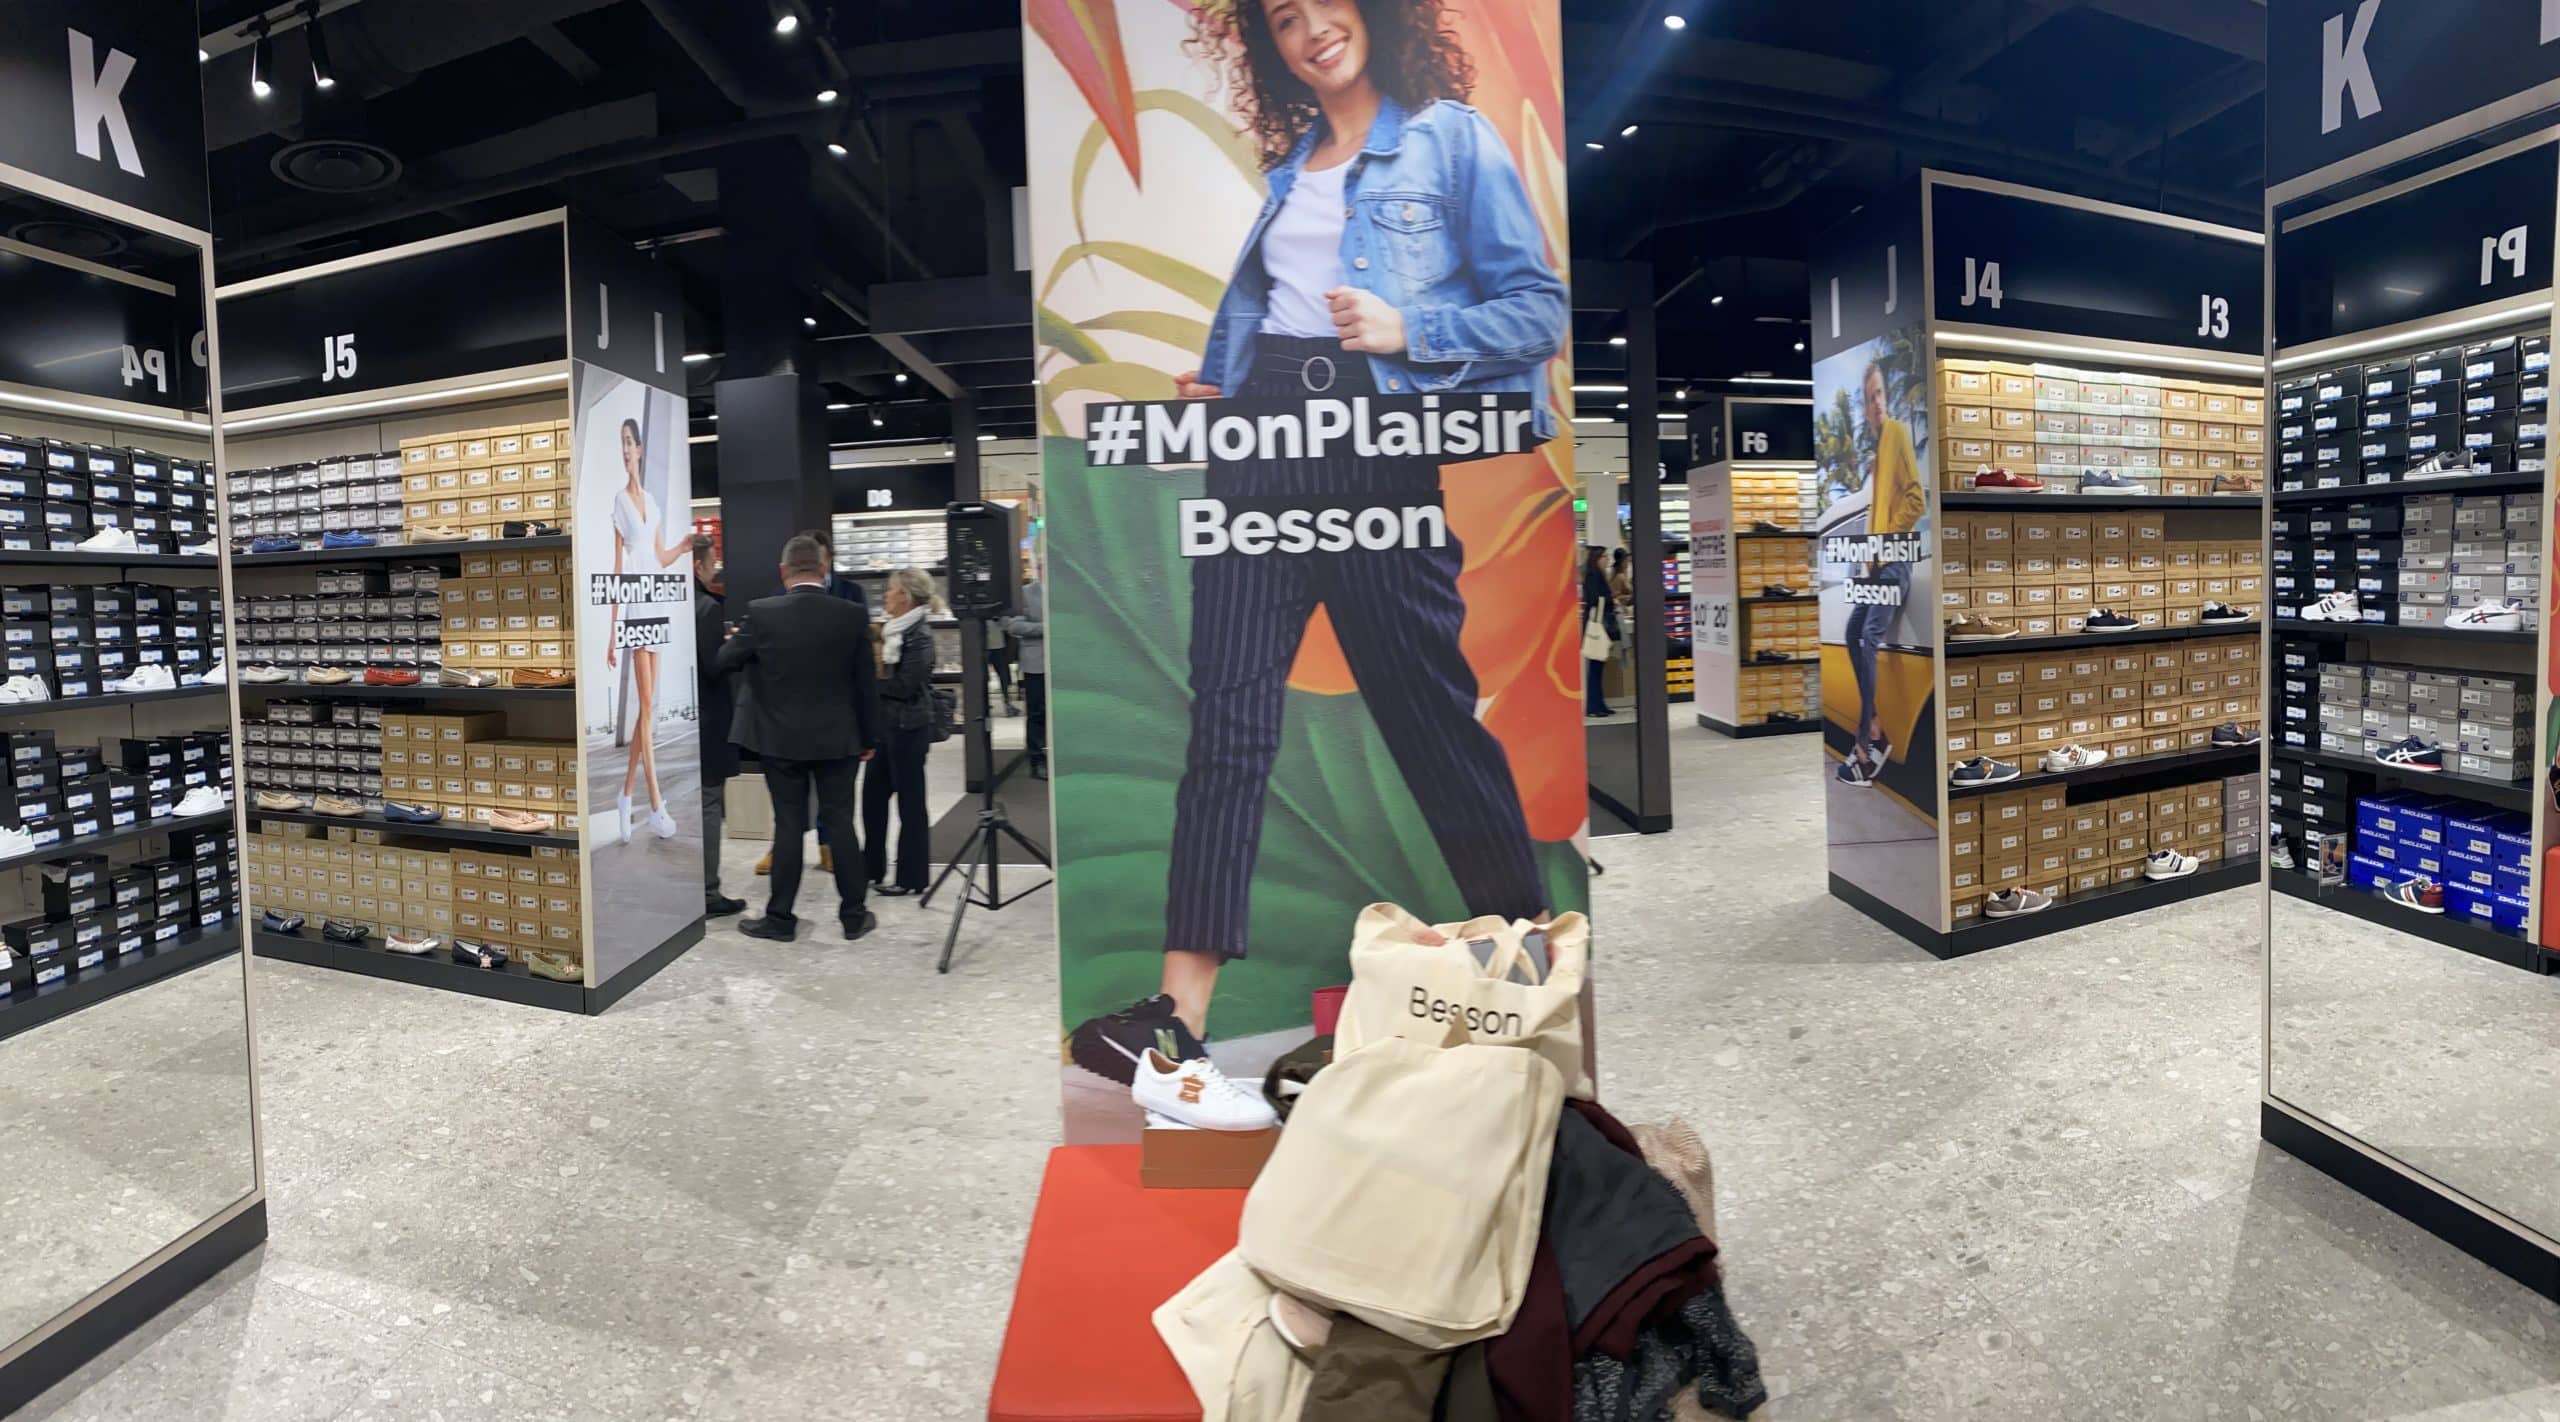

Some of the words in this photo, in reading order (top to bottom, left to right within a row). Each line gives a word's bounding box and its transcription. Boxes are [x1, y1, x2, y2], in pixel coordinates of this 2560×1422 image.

[2321, 0, 2382, 135] K
[67, 27, 145, 178] K
[1885, 245, 1897, 315] J
[1961, 257, 2004, 309] J4
[597, 281, 609, 350] J
[2198, 293, 2230, 340] J3
[321, 333, 358, 382] J5
[1087, 394, 1532, 466] #MonPlaisir
[1742, 431, 1768, 453] F6
[1179, 498, 1447, 557] Besson
[1826, 533, 1920, 562] #MonPlaisir
[592, 575, 687, 604] #MonPlaisir
[1844, 578, 1901, 606] Besson
[615, 621, 670, 648] Besson
